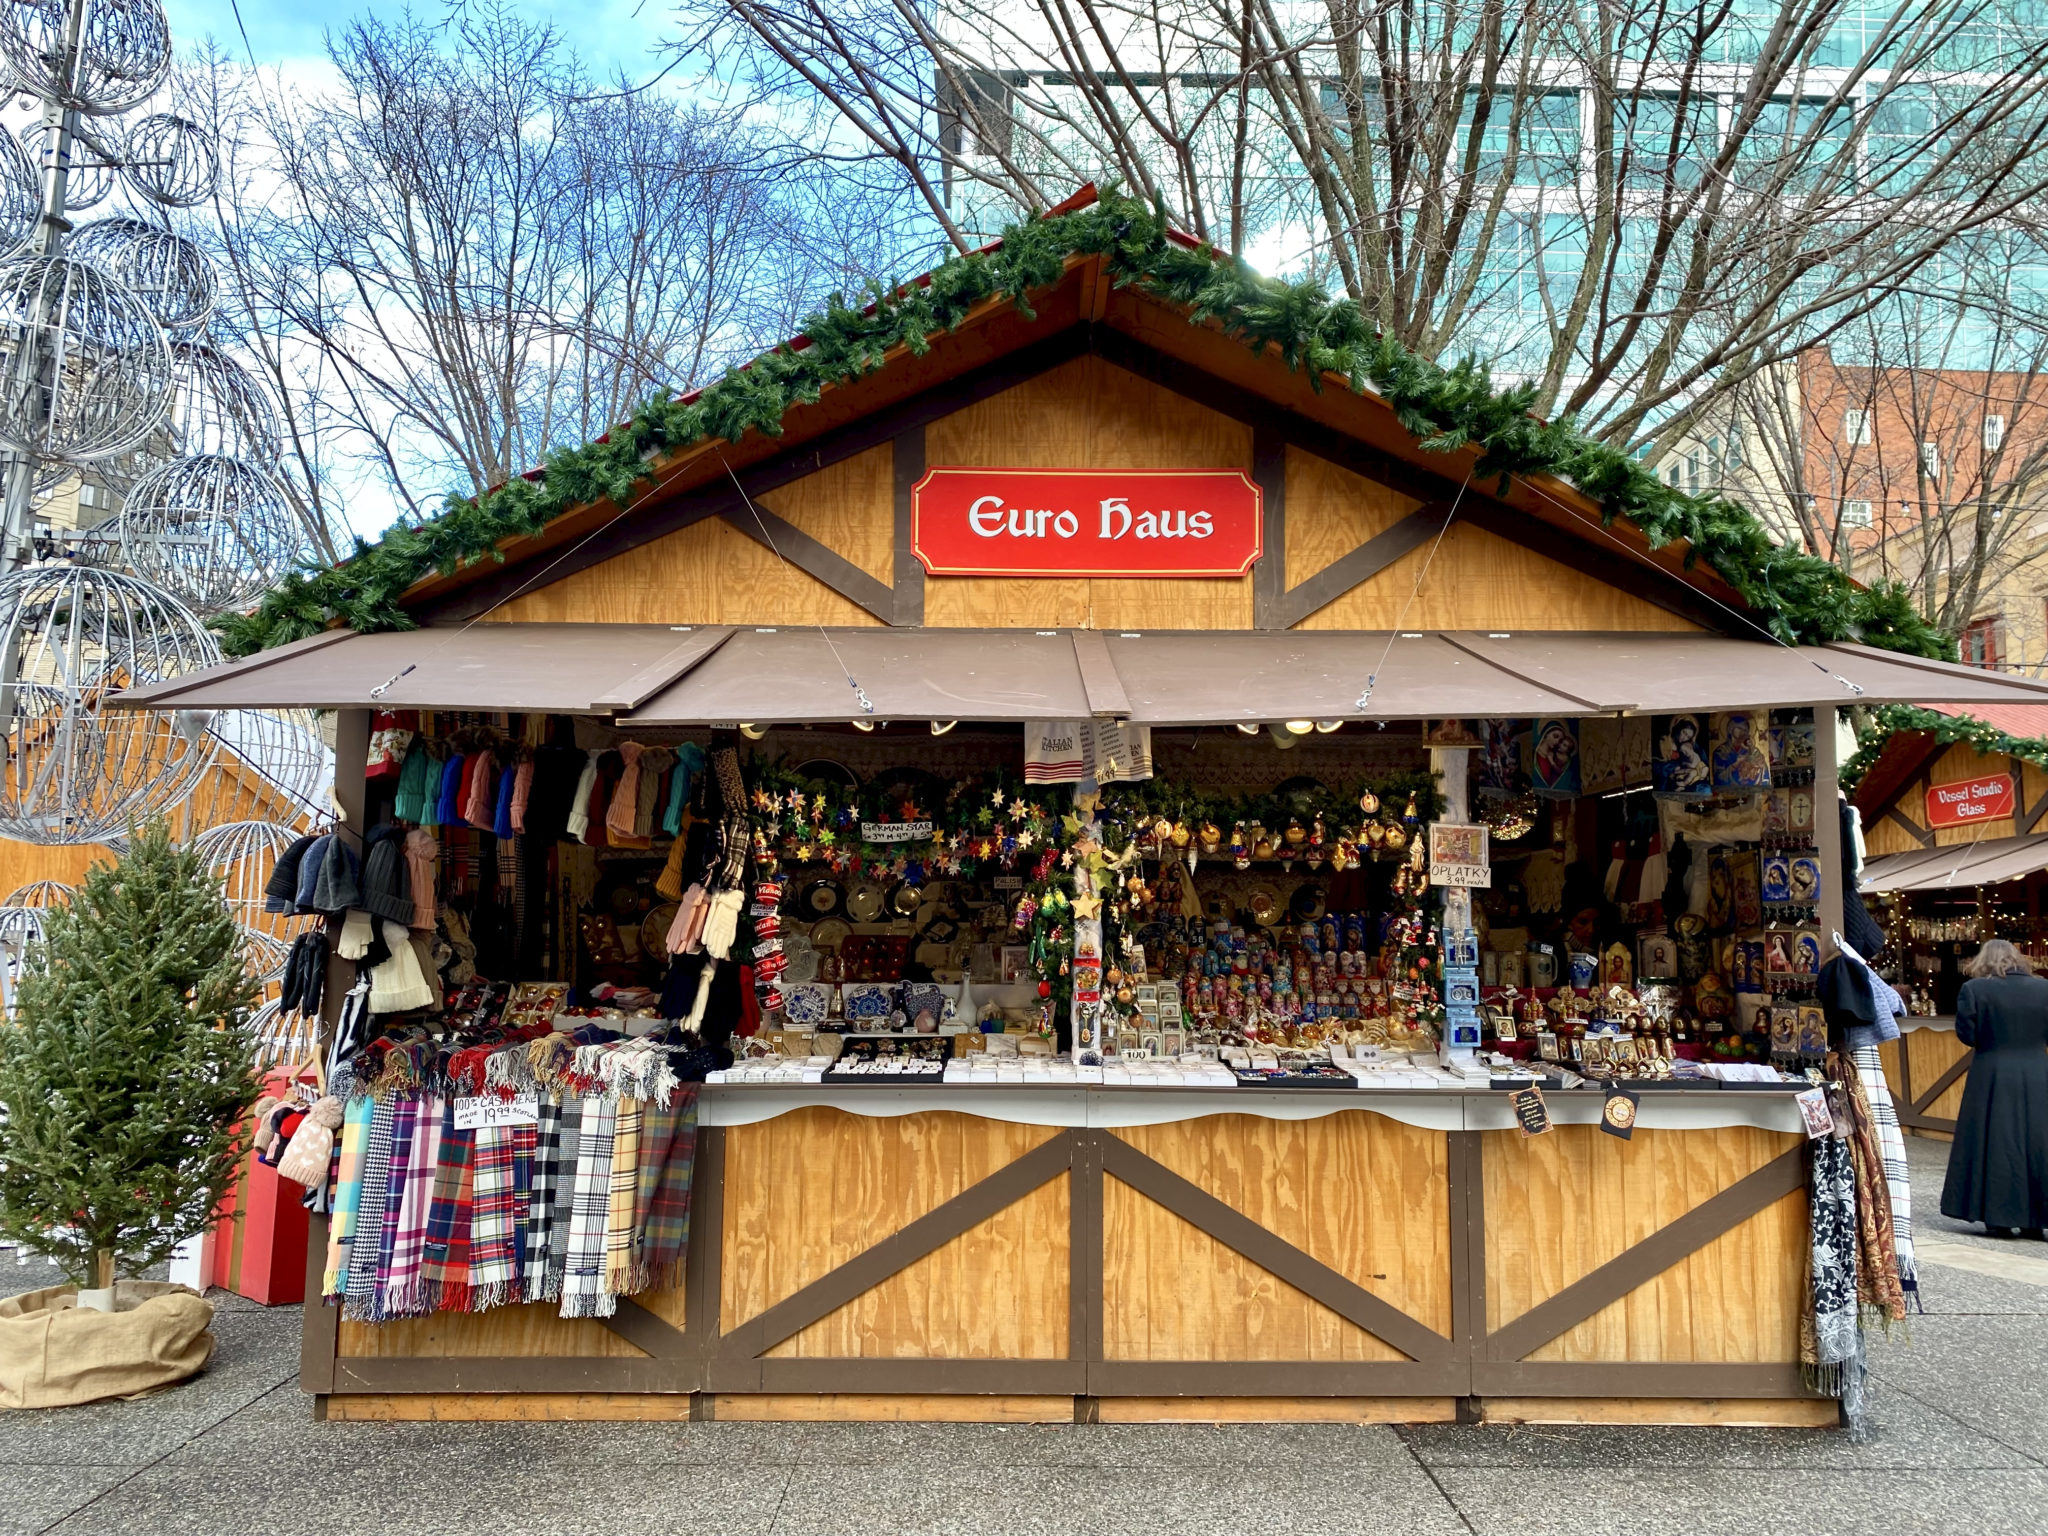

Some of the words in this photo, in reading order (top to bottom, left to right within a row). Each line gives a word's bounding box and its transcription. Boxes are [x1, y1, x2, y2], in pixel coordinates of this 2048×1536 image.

[968, 495, 1080, 539] Euro
[1098, 497, 1215, 540] Haus
[1938, 786, 1969, 804] Vessel
[1971, 781, 2003, 798] Studio
[1957, 802, 1986, 817] Glass
[863, 823, 903, 832] GERMAN
[906, 822, 931, 831] STAR
[1432, 865, 1489, 878] OPLATKY
[455, 1098, 478, 1111] 100%
[458, 1110, 478, 1120] MADE
